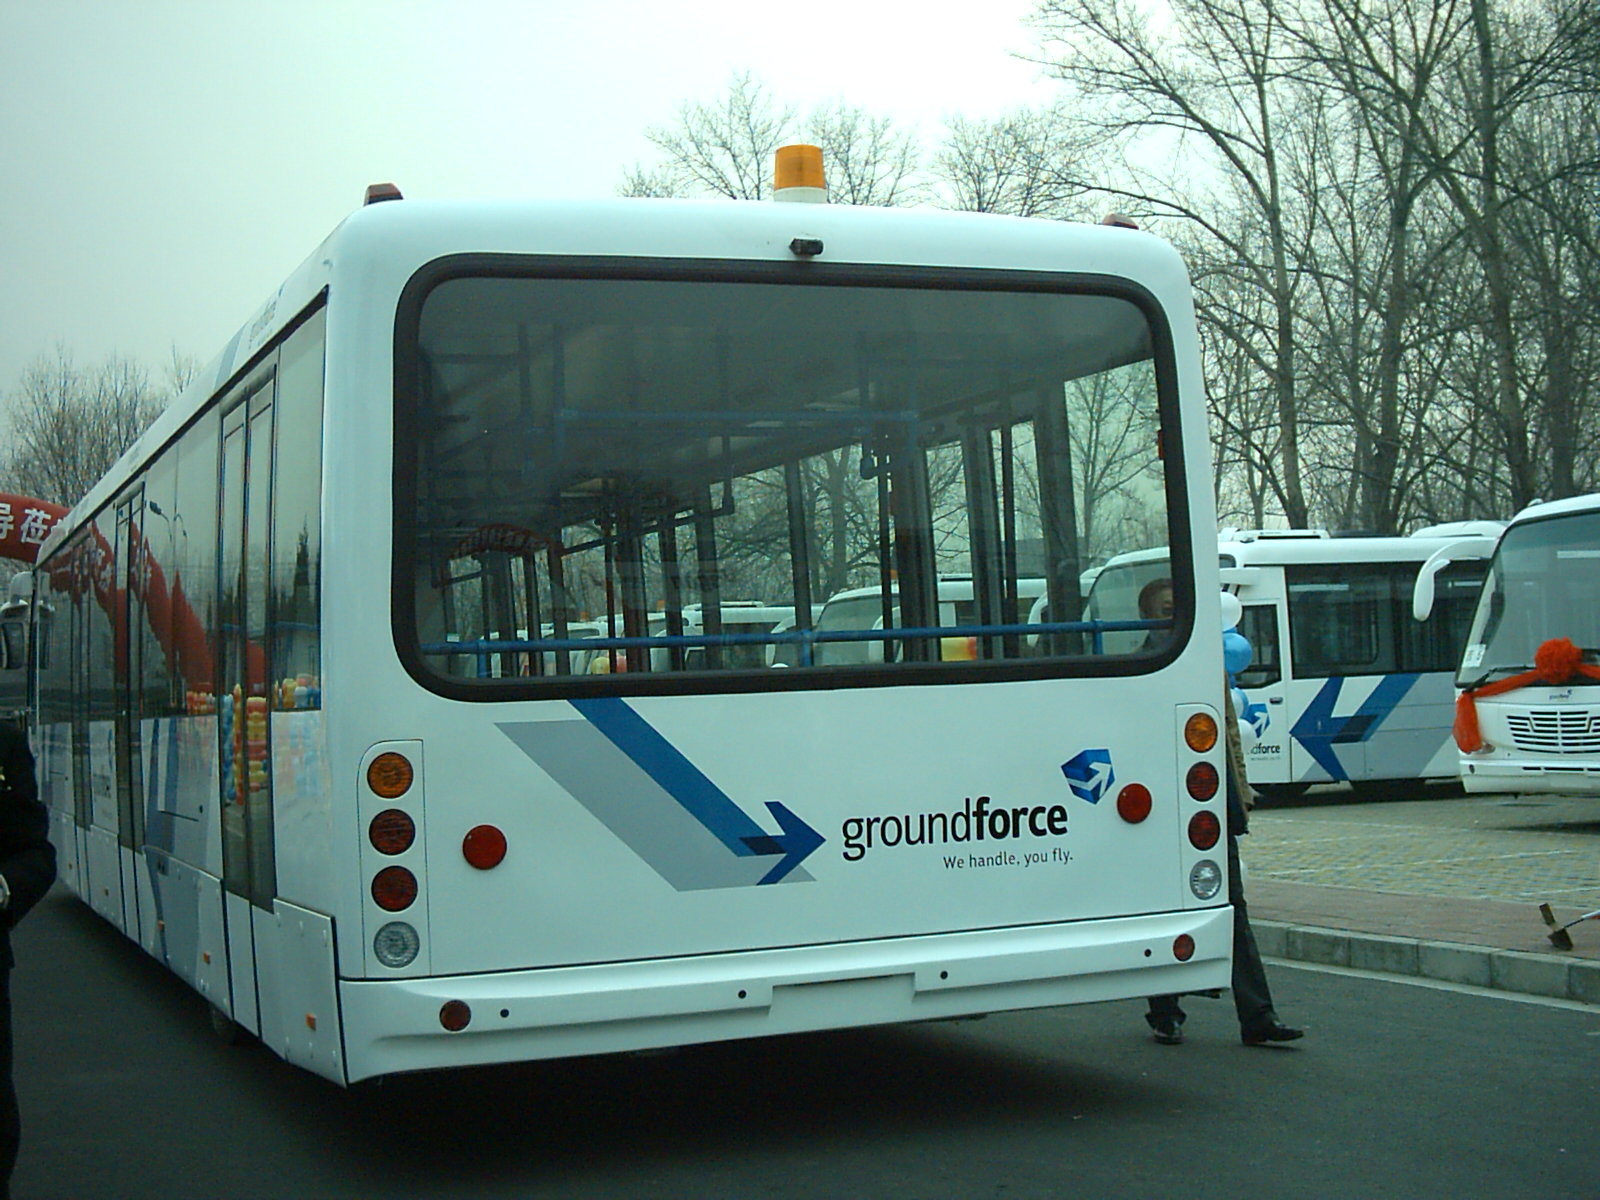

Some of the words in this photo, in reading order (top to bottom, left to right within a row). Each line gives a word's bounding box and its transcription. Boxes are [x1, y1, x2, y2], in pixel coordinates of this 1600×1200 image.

[842, 796, 1069, 862] groundforce
[943, 855, 965, 869] We
[1023, 852, 1048, 868] you
[1052, 847, 1073, 865] fly.
